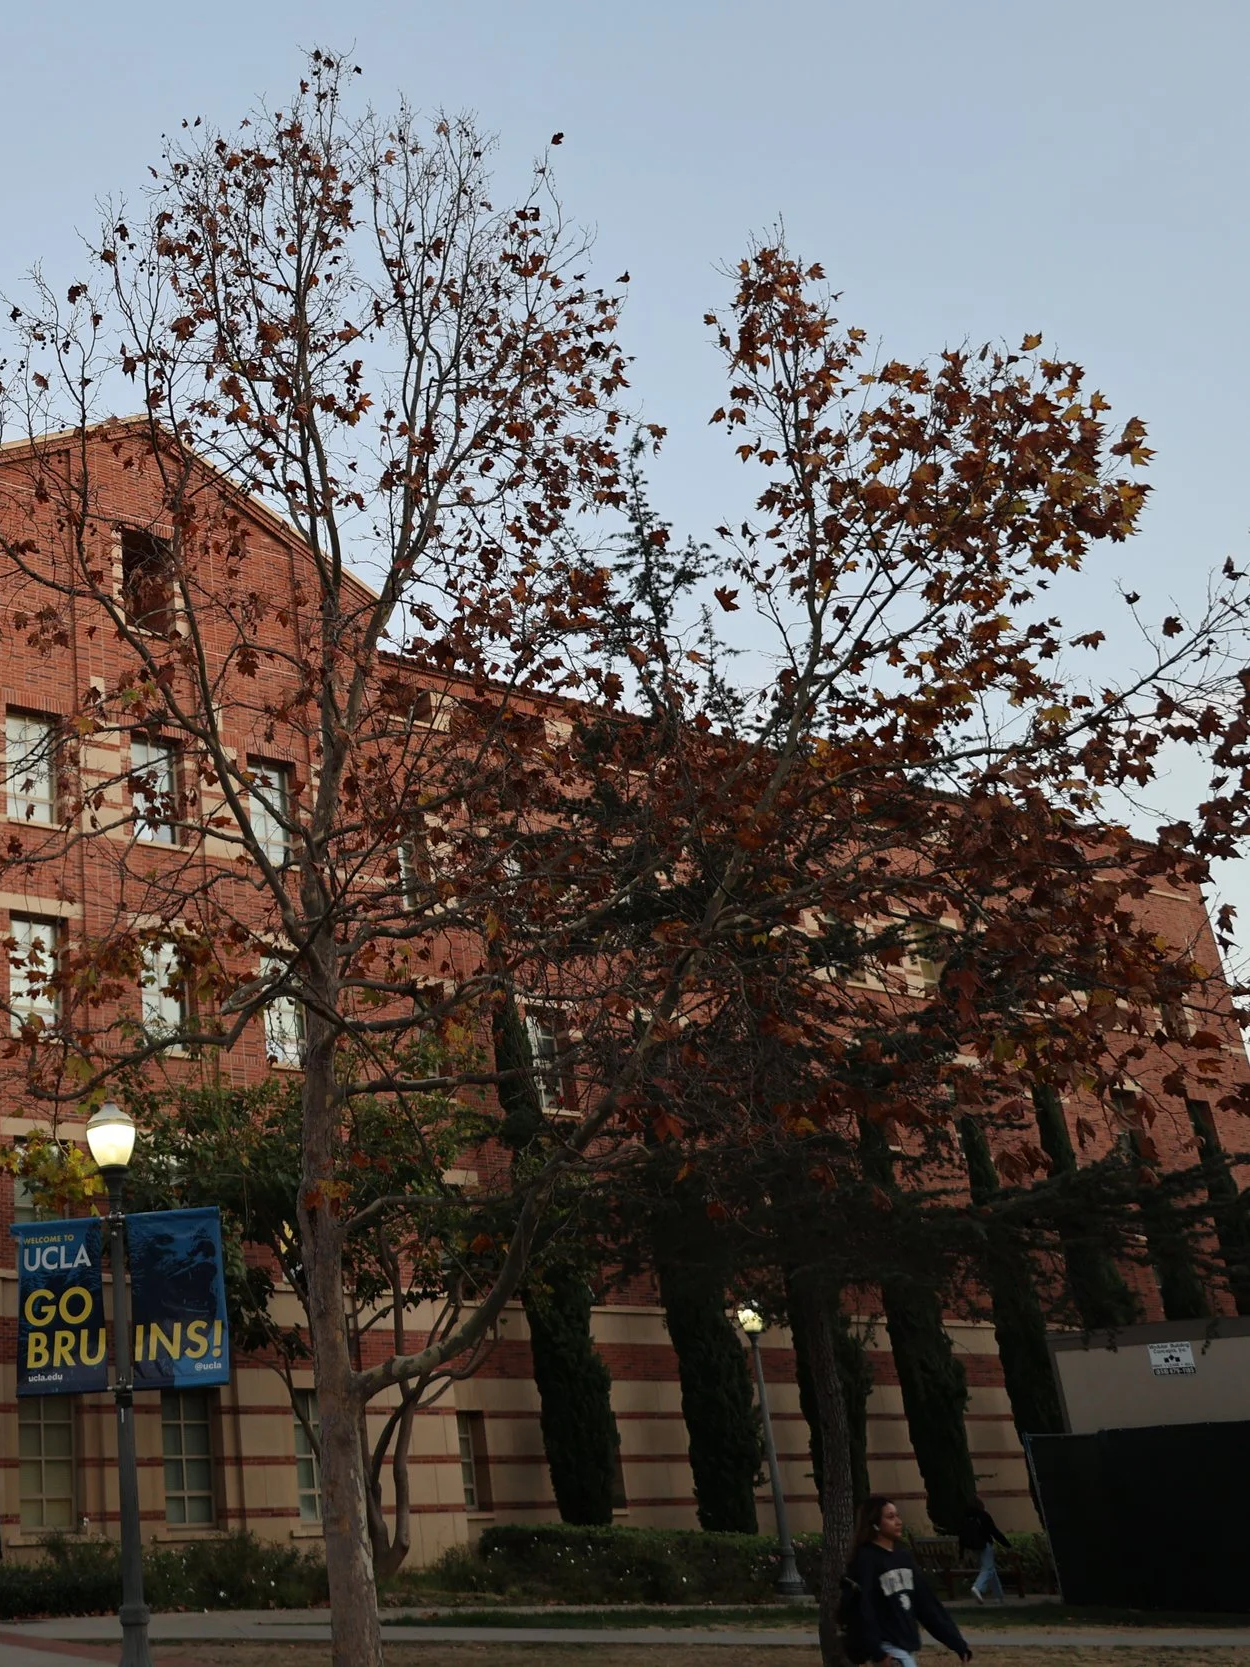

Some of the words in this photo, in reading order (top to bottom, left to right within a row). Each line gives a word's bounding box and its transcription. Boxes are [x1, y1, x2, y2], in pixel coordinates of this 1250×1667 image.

[23, 1235, 61, 1245] WELCOME
[64, 1234, 74, 1242] TO
[23, 1244, 92, 1272] UCLA
[24, 1286, 93, 1327] GO
[26, 1328, 107, 1369] BRU
[134, 1320, 223, 1362] INS!
[194, 1361, 222, 1371] @ucla
[28, 1373, 63, 1383] ucla.edu
